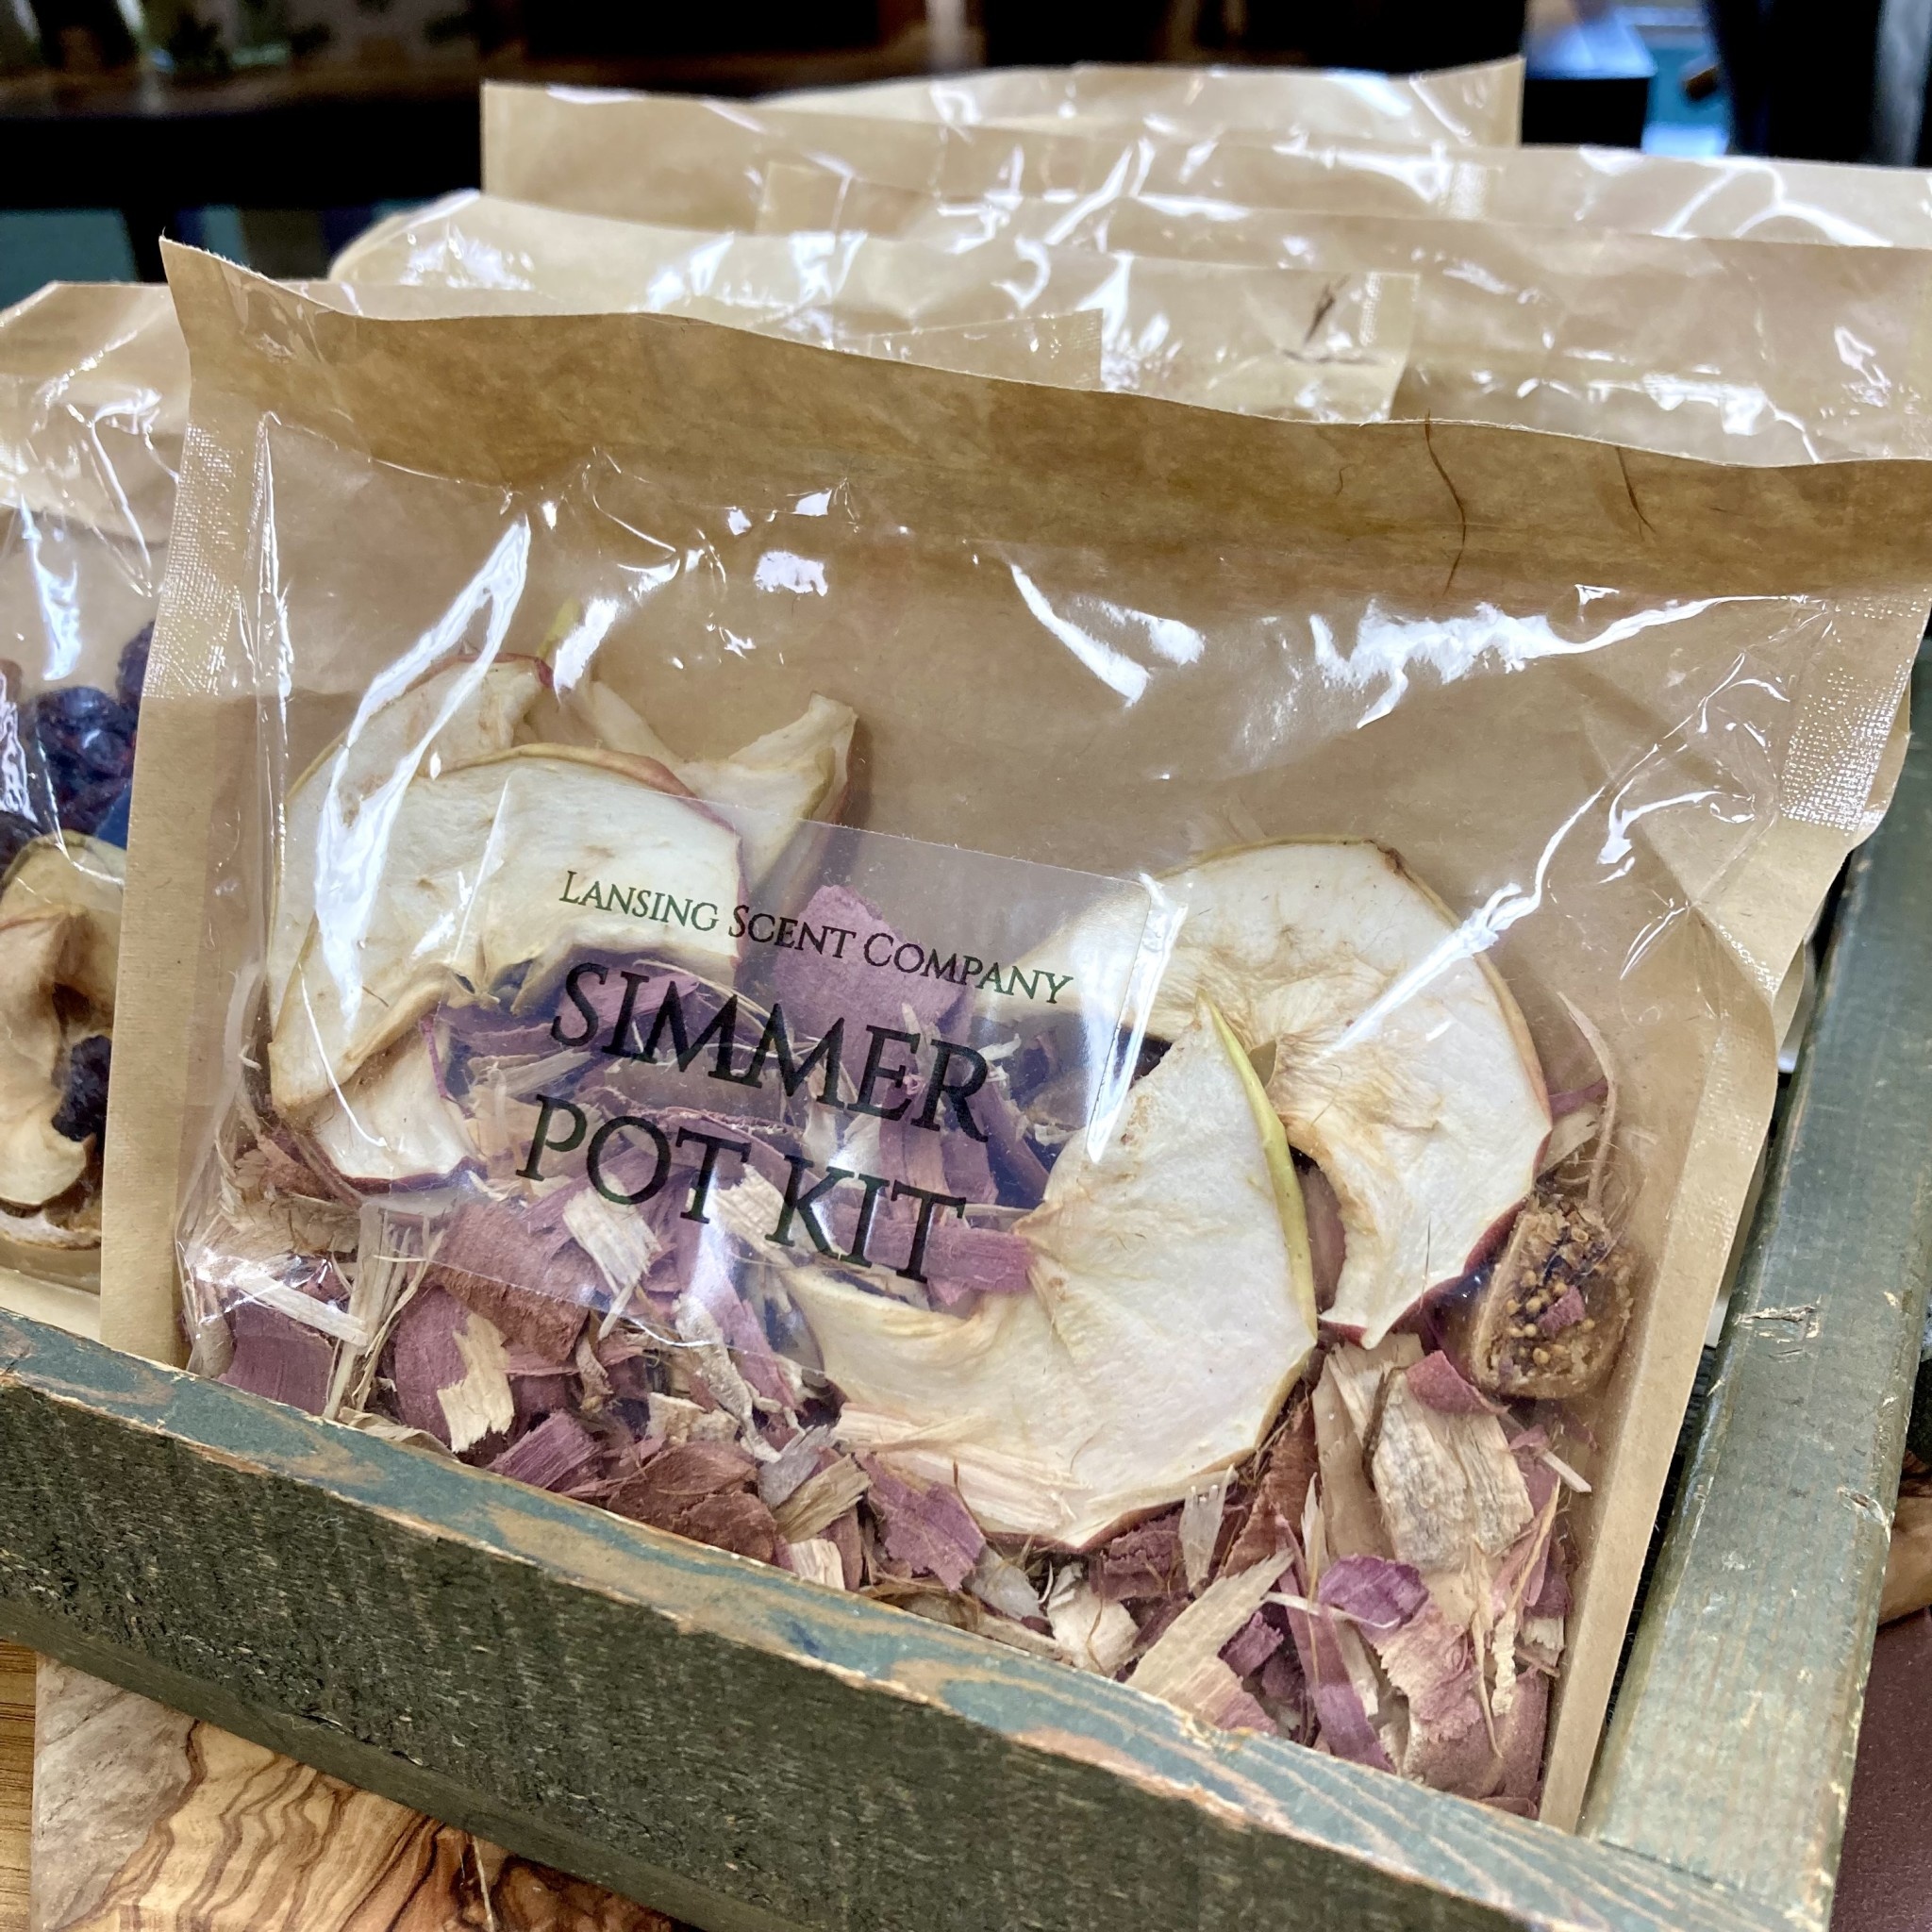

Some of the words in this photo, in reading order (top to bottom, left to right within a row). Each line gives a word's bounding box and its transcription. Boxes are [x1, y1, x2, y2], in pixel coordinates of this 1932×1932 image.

[560, 872, 719, 931] LANSING
[729, 906, 856, 958] SCENT
[864, 934, 1074, 1004] COMPANY
[551, 962, 989, 1143] SIMMER
[515, 1095, 751, 1224] POT
[765, 1156, 966, 1283] KIT
